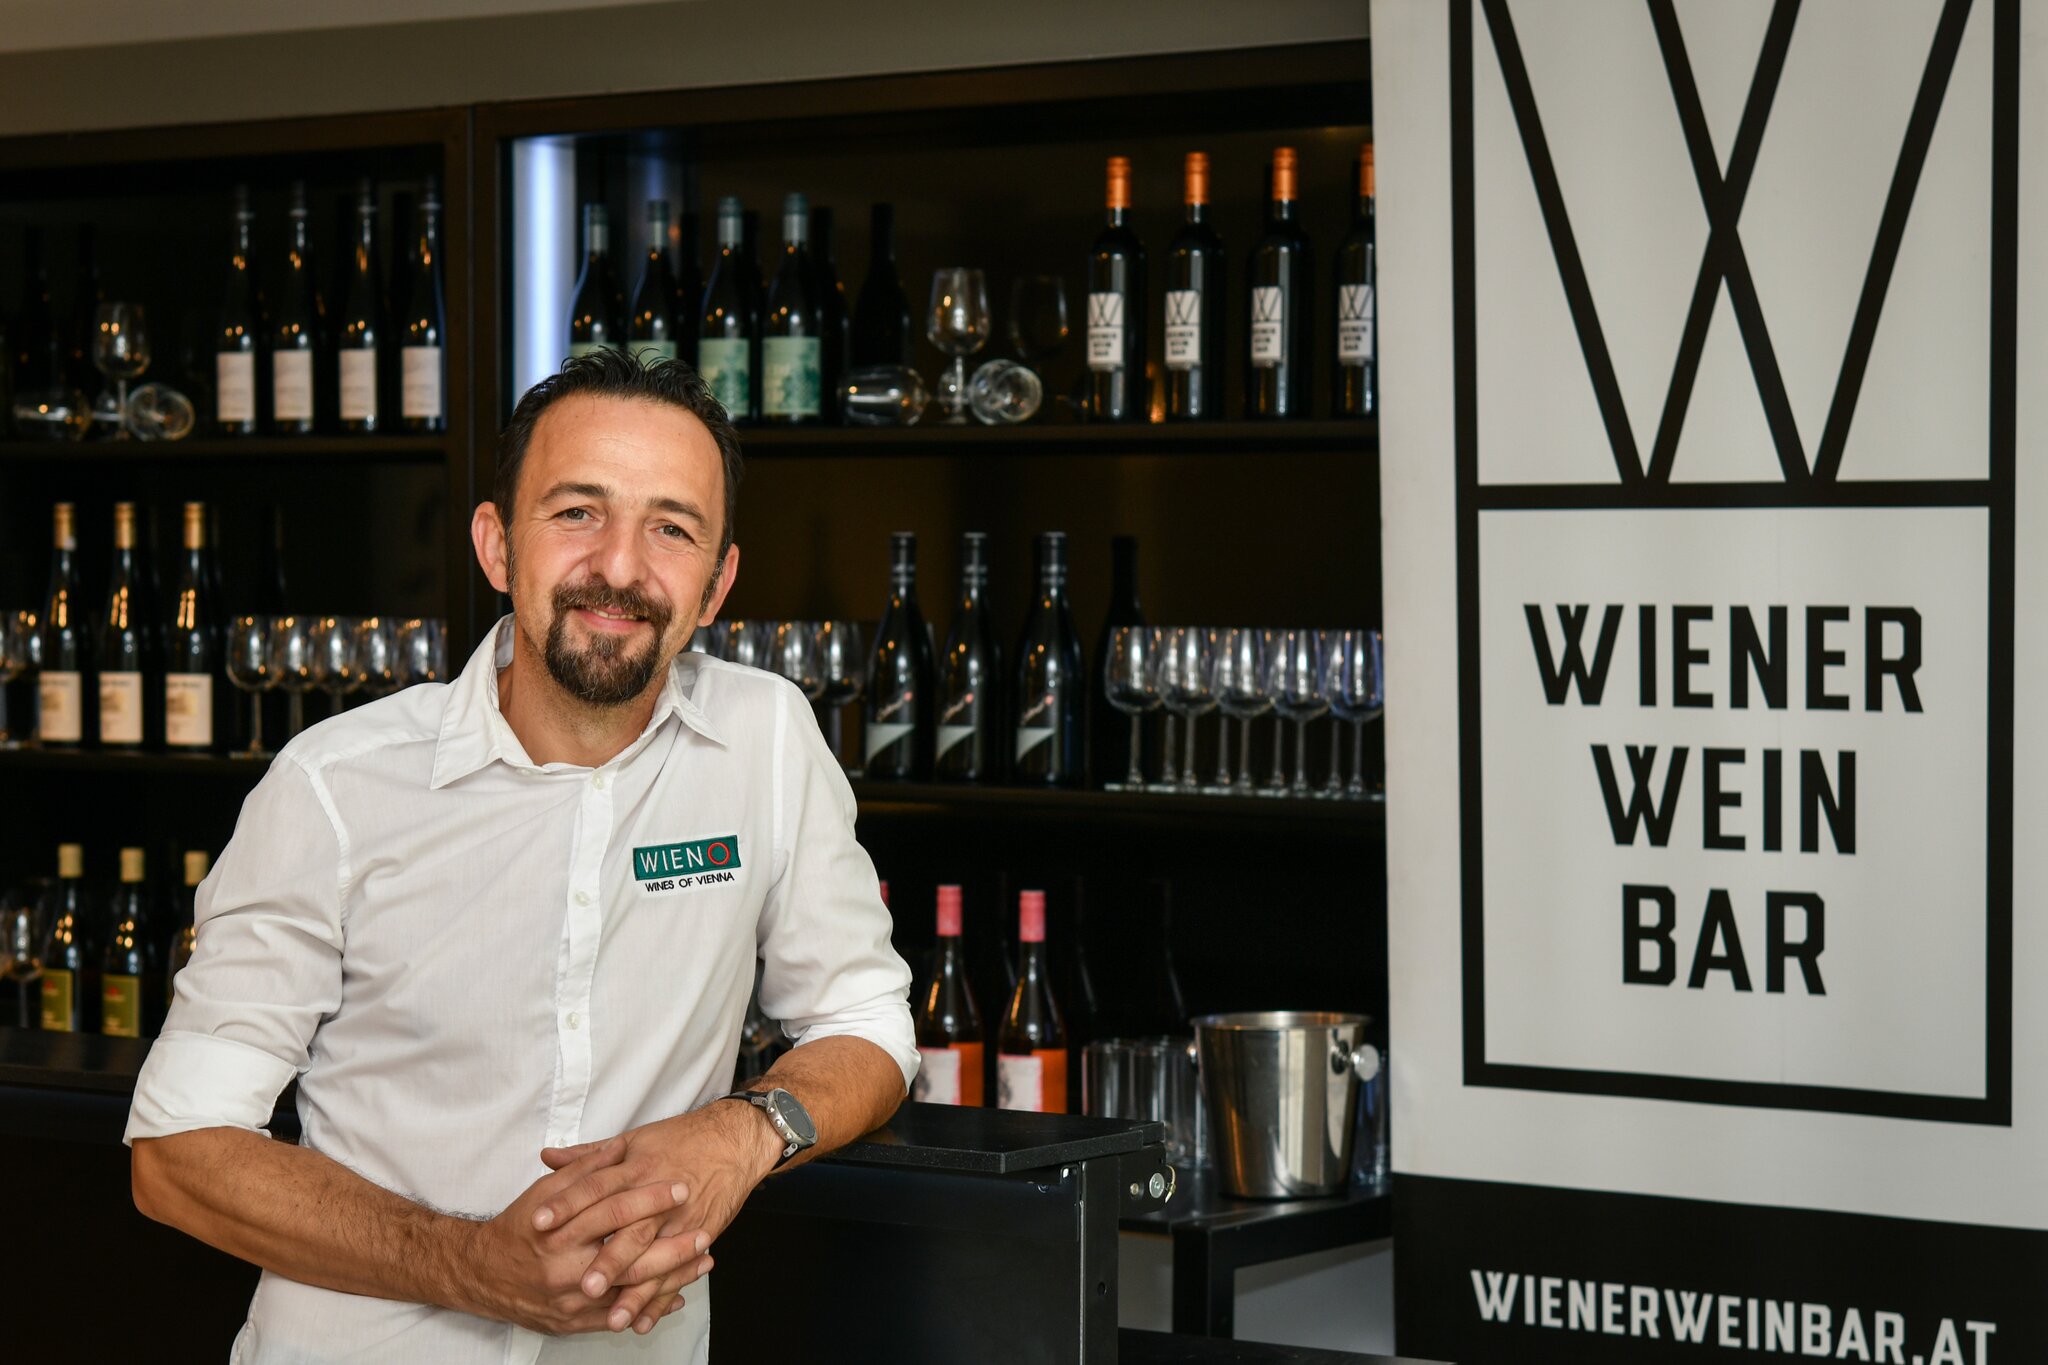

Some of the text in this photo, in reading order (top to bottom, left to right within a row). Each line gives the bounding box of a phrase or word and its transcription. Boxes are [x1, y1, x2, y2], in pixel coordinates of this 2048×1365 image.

[1480, 0, 1975, 485] W
[1523, 603, 1924, 713] WIENER
[1590, 743, 1856, 855] WEIN
[646, 873, 735, 892] WINES OF VIENNA
[1622, 882, 1827, 996] BAR
[1470, 1269, 1997, 1365] WIENERWEINBAR.AT
